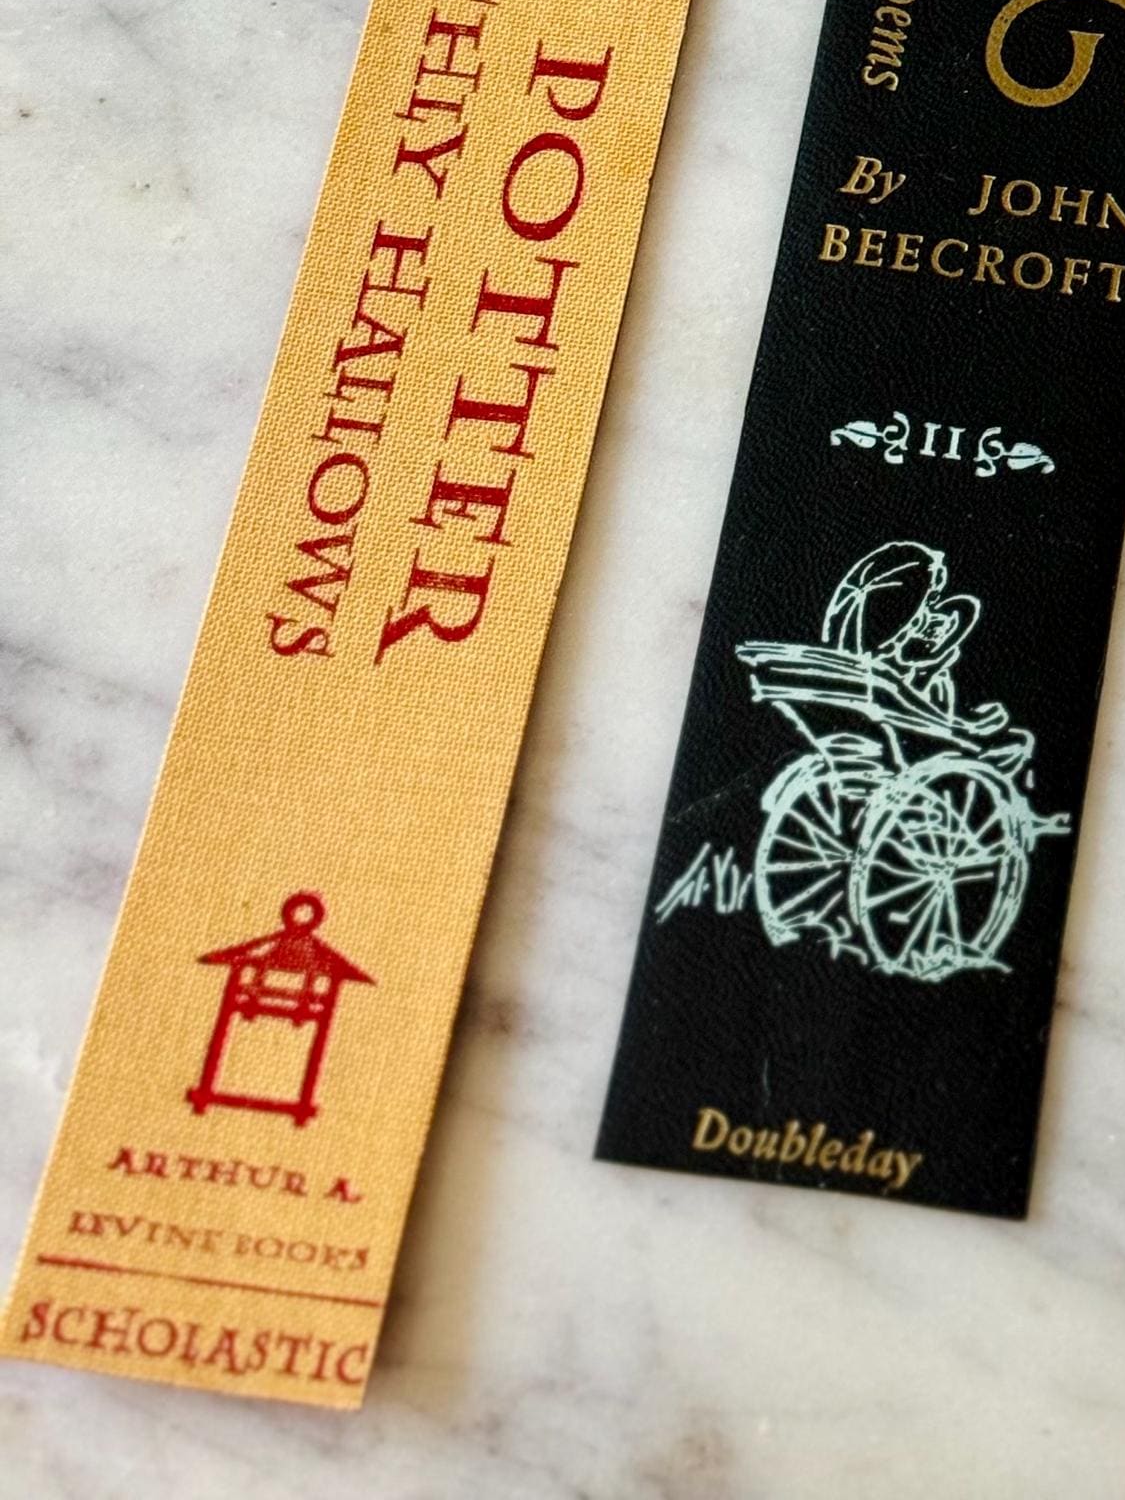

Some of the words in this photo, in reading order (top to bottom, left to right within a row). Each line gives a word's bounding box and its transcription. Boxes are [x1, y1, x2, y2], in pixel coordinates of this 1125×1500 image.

[840, 155, 905, 204] By
[374, 40, 614, 665] POTTER
[265, 220, 433, 659] HALLOWS
[106, 1148, 307, 1197] ARTHUR
[692, 1107, 923, 1188] Doubleday
[67, 1210, 225, 1252] LEVINE
[234, 1234, 371, 1271] BOOKS
[19, 1299, 369, 1386] SCHOLASTIC
